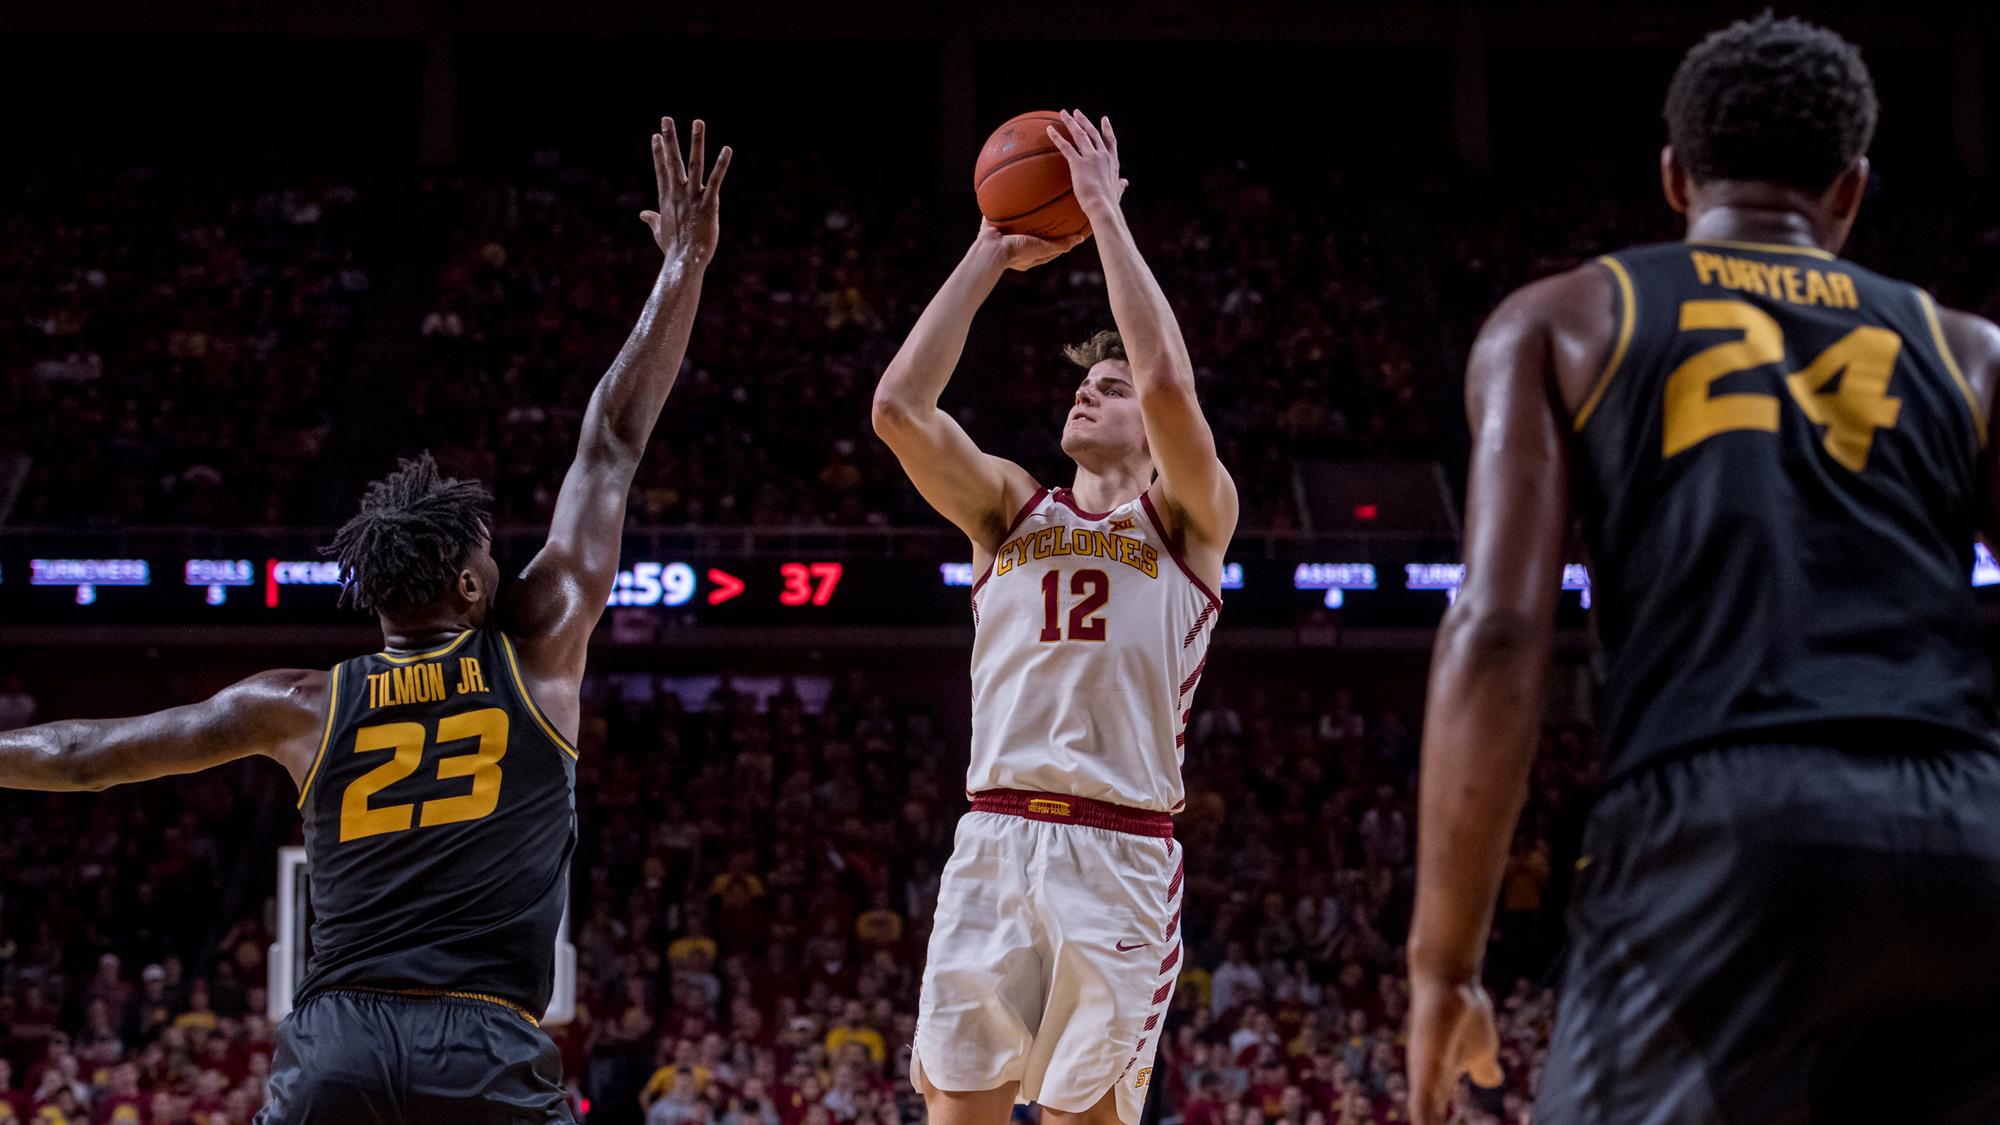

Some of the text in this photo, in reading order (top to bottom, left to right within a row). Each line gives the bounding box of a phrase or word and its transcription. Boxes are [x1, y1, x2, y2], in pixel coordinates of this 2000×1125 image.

[1691, 250, 1859, 310] PURYEAR
[1662, 300, 1902, 473] 24
[1109, 516, 1136, 532] XII
[30, 559, 149, 581] TURNOVERS
[185, 559, 253, 581] FOULS
[273, 561, 352, 585] CYCLO
[997, 526, 1158, 579] CYCLONES
[1295, 563, 1376, 584] ASSISTS
[606, 561, 697, 607] :59
[780, 562, 843, 607] 37
[1040, 568, 1109, 643] 12
[367, 657, 490, 709] TILMON JR.
[339, 707, 510, 843] 23
